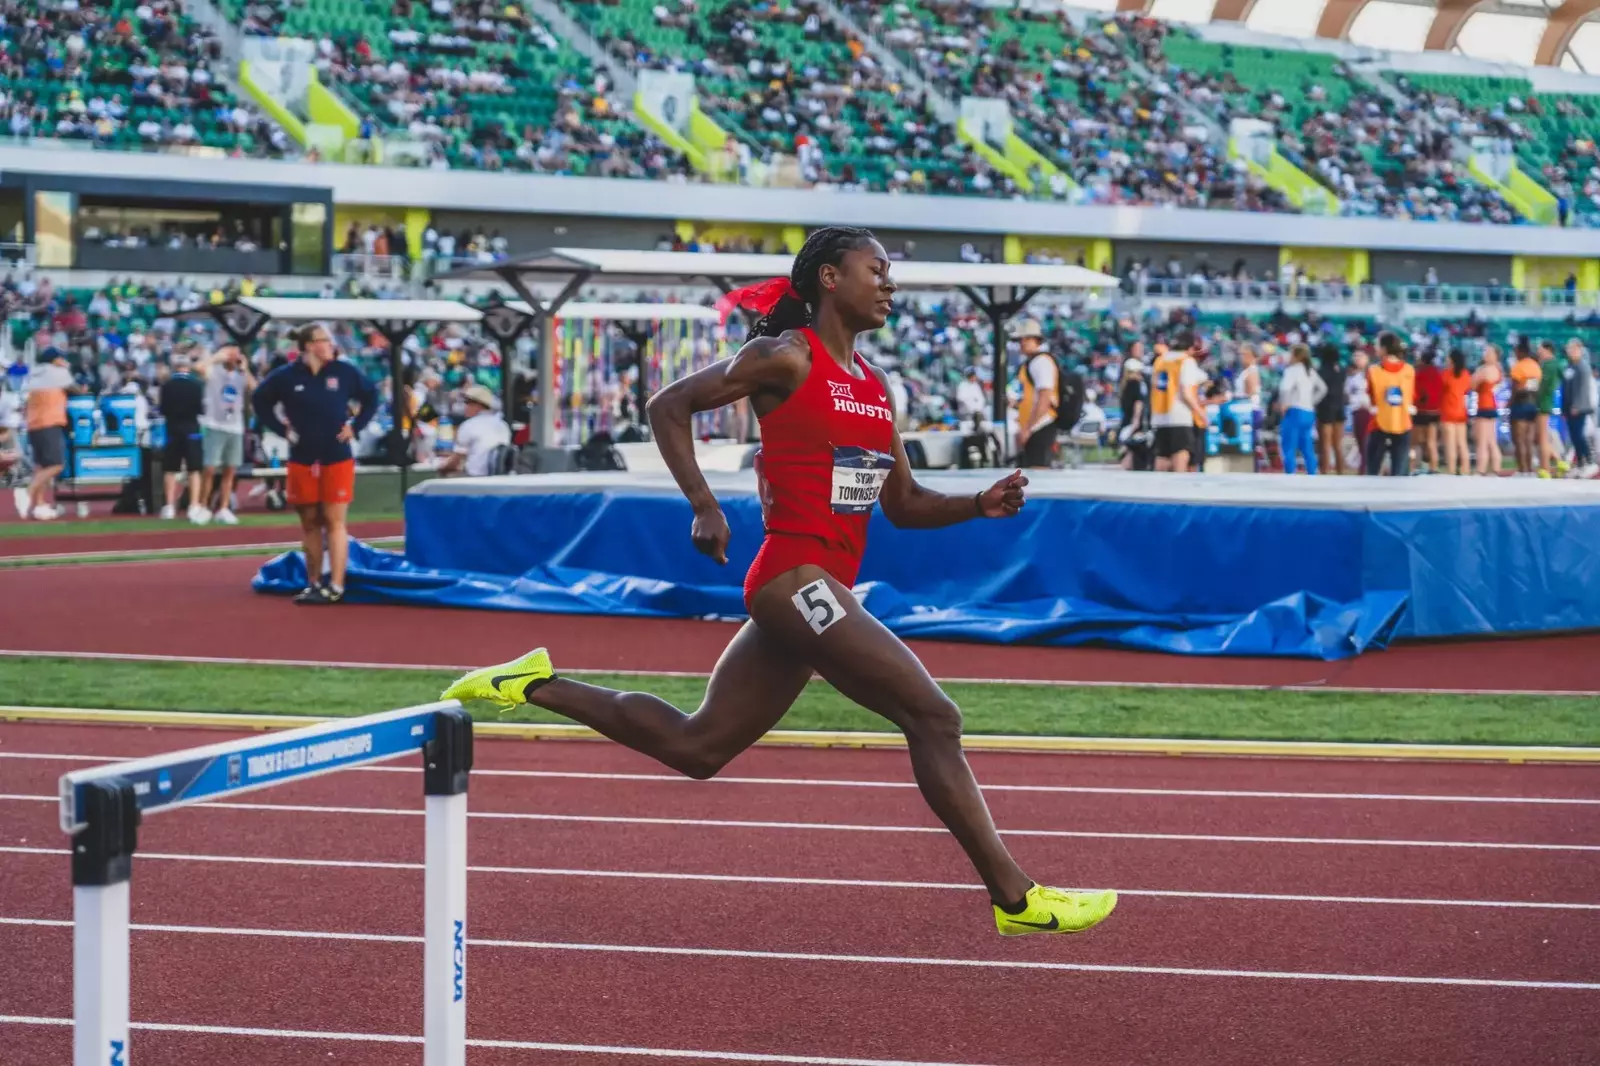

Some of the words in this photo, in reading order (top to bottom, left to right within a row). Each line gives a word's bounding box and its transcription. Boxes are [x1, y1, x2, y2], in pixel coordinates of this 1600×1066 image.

[833, 399, 892, 422] HOUSTO
[801, 584, 834, 627] 5
[248, 754, 274, 777] TRACK
[283, 747, 305, 769] FIELD
[453, 920, 463, 1002] NCAA
